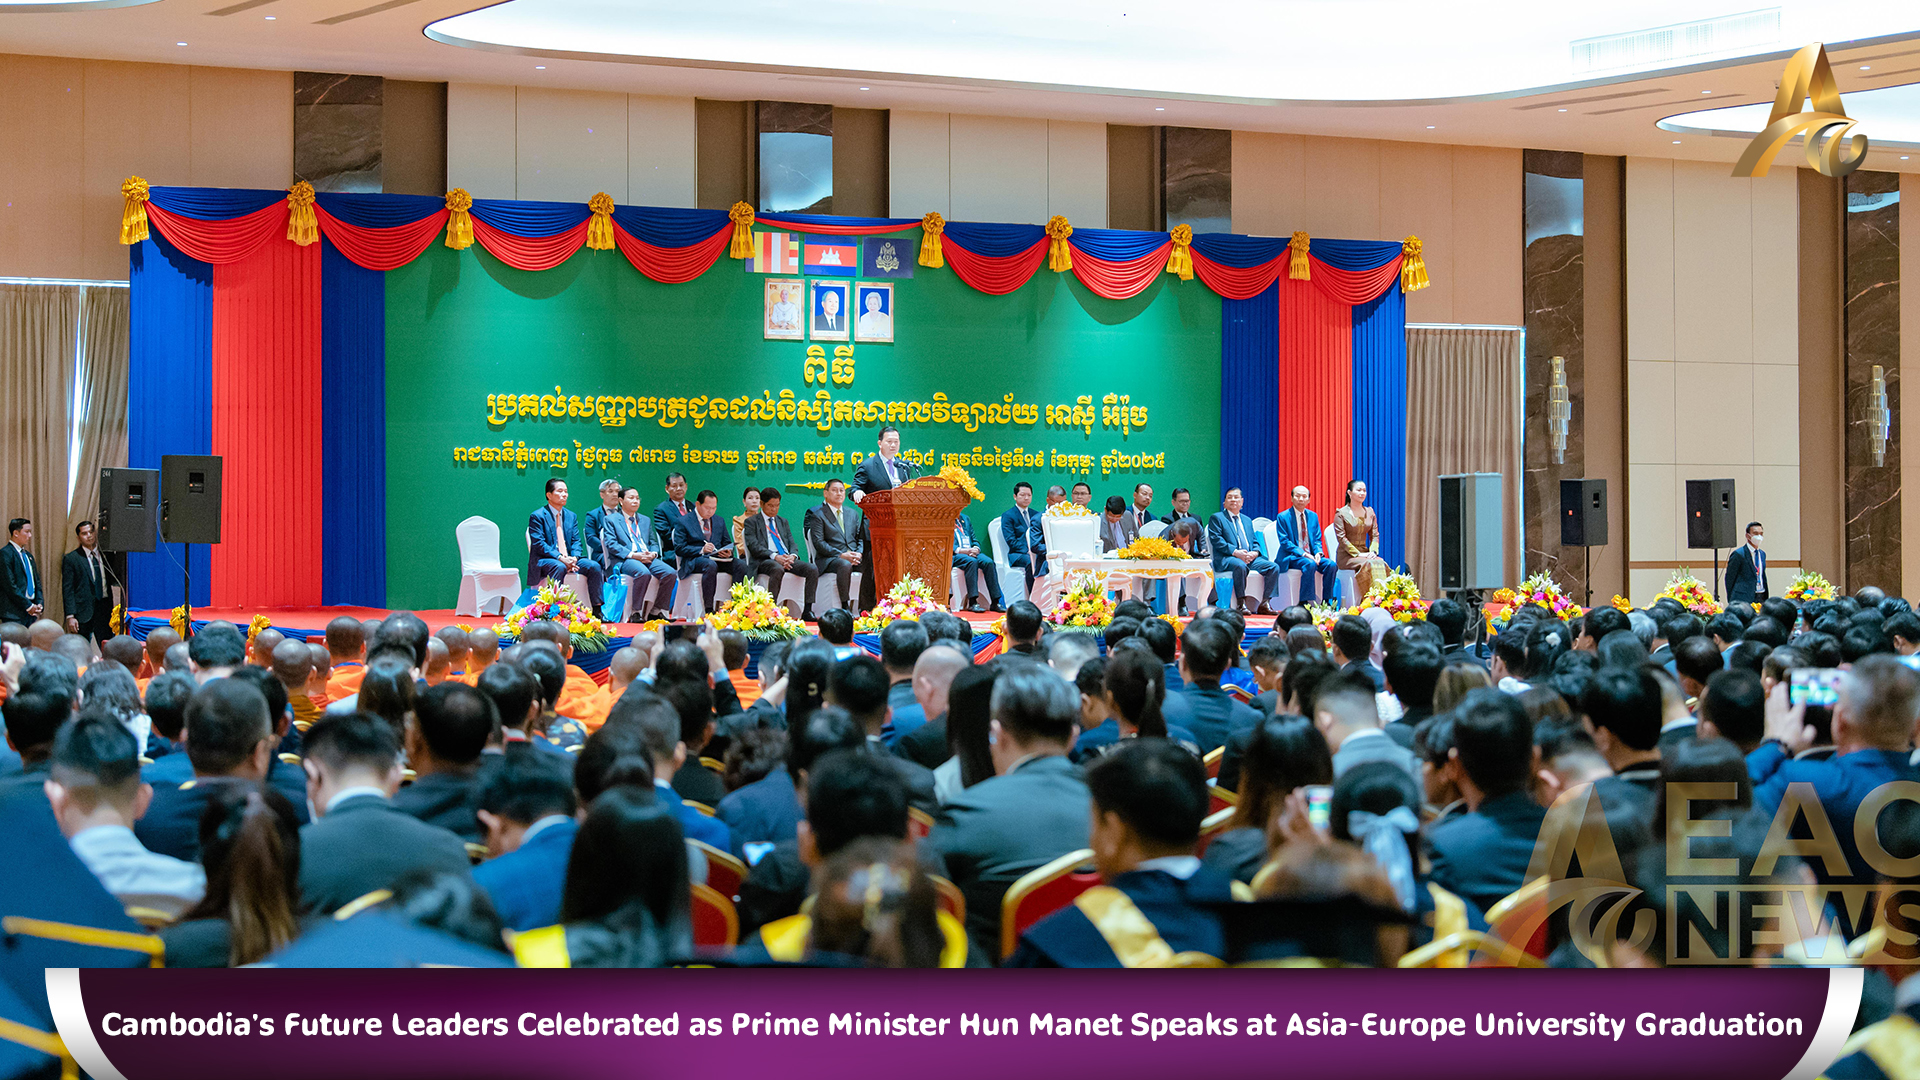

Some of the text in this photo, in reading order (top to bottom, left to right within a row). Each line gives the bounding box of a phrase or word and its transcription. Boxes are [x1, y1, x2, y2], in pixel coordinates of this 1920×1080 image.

[803, 344, 856, 384] ពិធី
[453, 440, 569, 469] រាជធានីភ្នំពេញ
[573, 439, 623, 470] ថ្ងៃពុធ
[746, 444, 797, 471] ឆ្នាំរោង
[1101, 449, 1165, 475] ឆ្នាំ២០២៥
